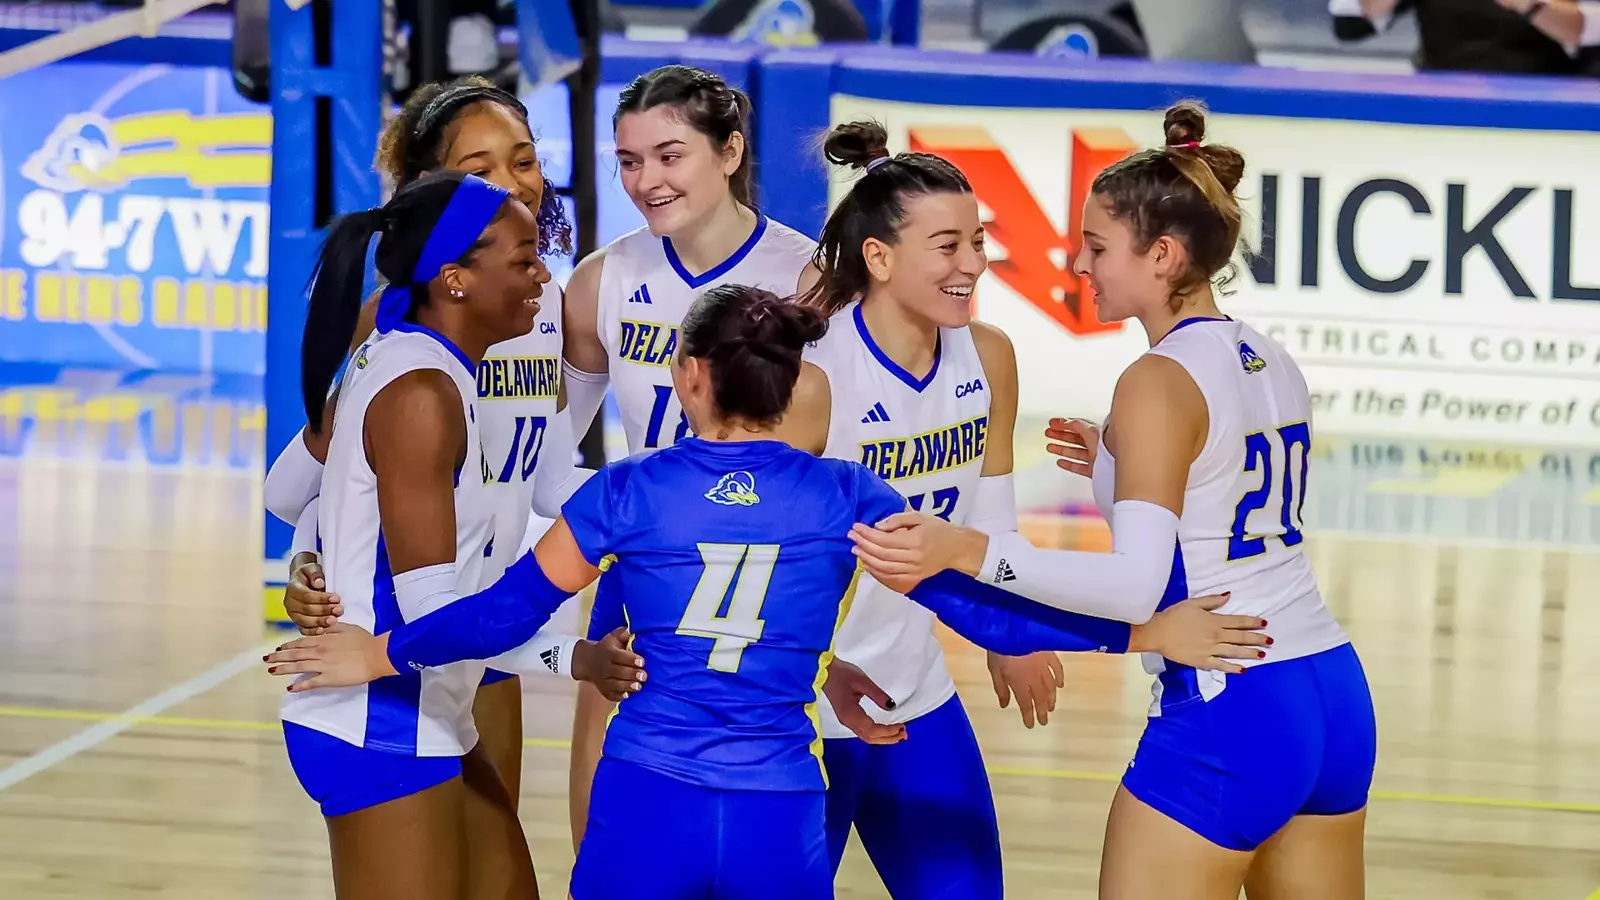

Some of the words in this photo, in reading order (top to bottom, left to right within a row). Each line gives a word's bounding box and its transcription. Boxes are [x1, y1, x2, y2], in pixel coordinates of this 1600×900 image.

[0, 269, 27, 323] E
[540, 322, 557, 334] CAA
[955, 379, 983, 399] CAA
[1352, 389, 1407, 417] the
[1418, 388, 1531, 424] Power
[1541, 397, 1579, 426] of
[497, 416, 547, 482] 10
[861, 416, 988, 480] DELAWARE
[1227, 420, 1311, 561] 20
[675, 542, 781, 674] 4
[552, 645, 560, 674] adidas
